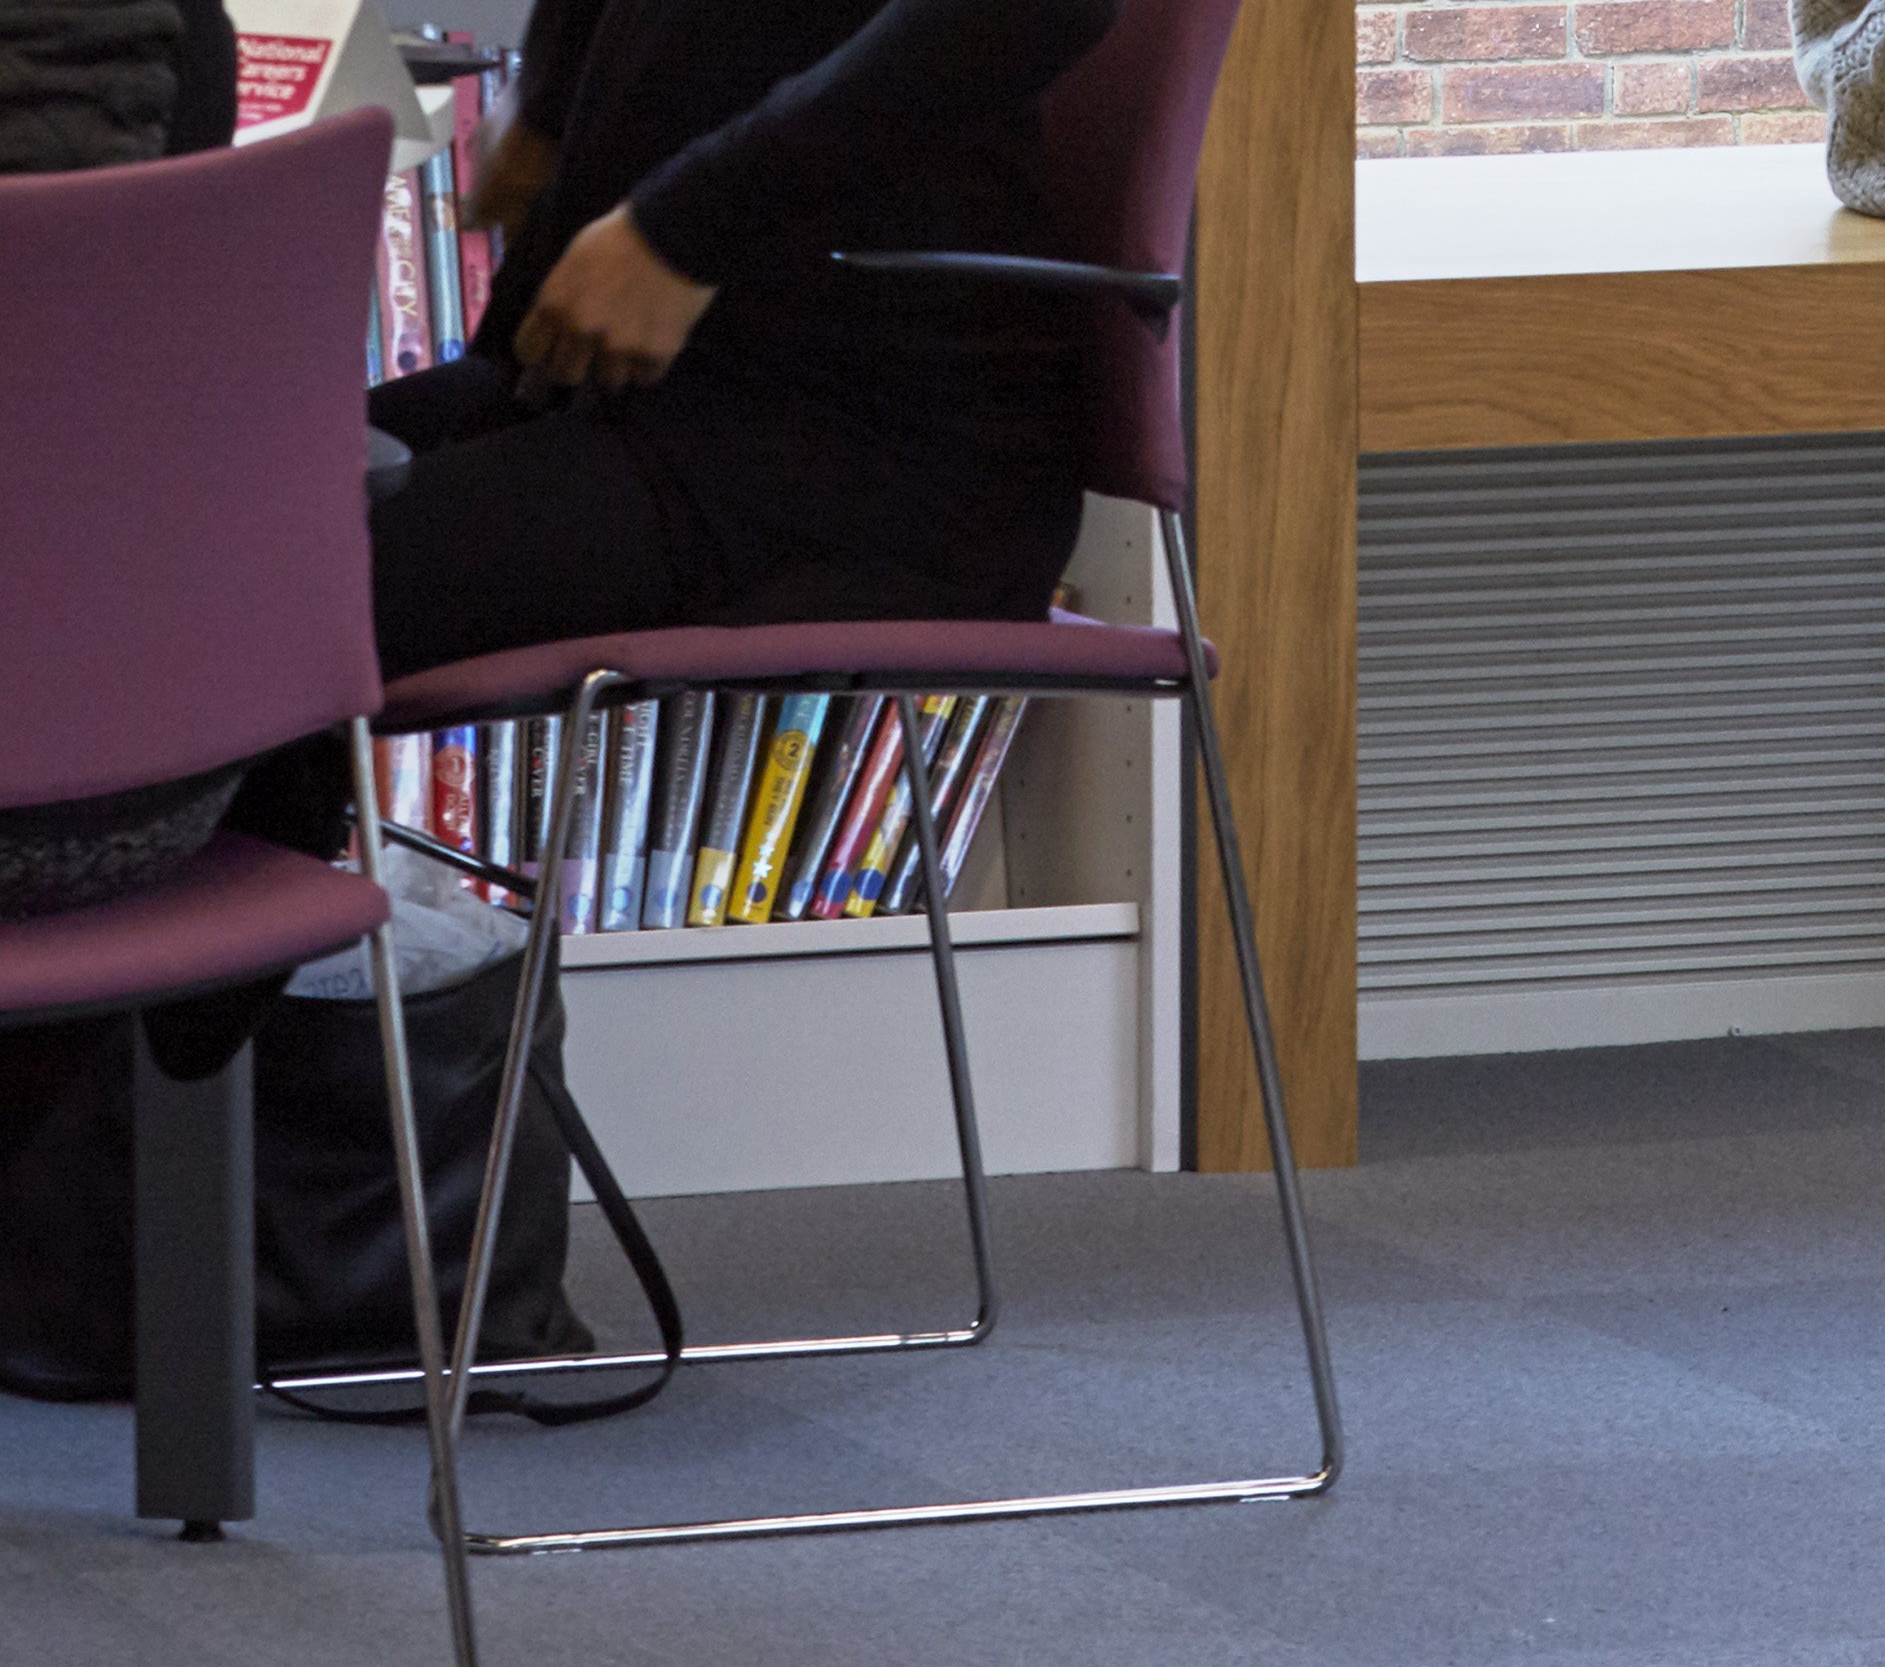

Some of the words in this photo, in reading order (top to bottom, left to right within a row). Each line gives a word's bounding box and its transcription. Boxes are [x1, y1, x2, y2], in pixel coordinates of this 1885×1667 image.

[239, 38, 326, 64] National
[237, 81, 297, 100] ervice
[391, 259, 418, 317] CITY
[585, 732, 602, 765] GIRL
[786, 740, 802, 759] 2
[617, 744, 635, 787] TIME
